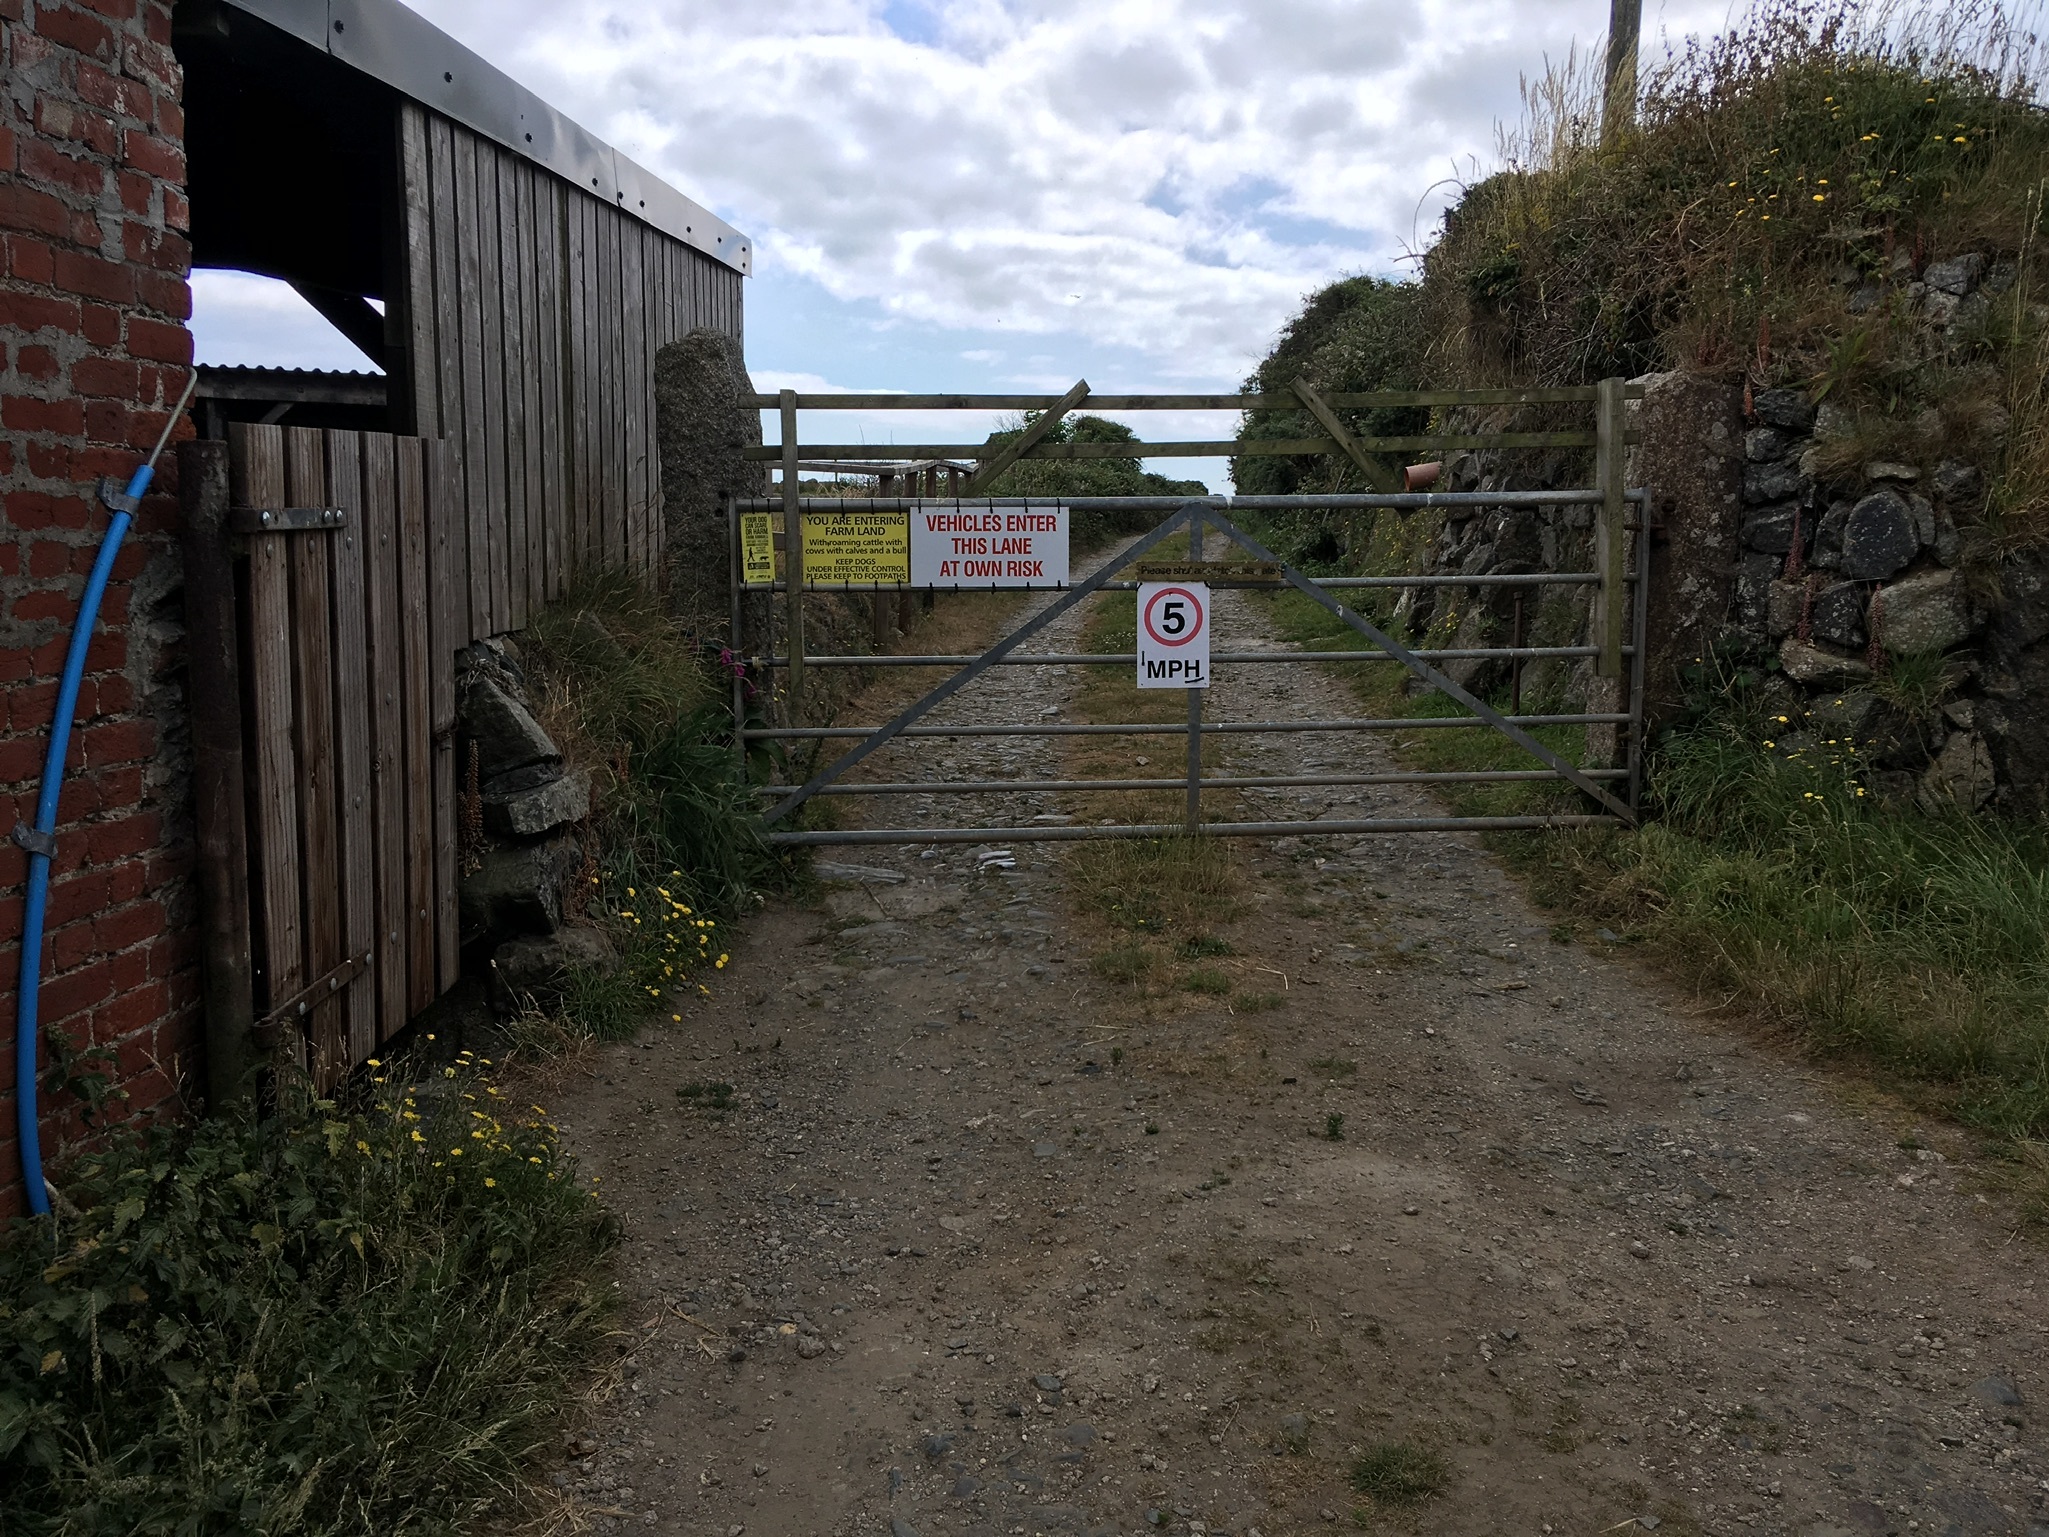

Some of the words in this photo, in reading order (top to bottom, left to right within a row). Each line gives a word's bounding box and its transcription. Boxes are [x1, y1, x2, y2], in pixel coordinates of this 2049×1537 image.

[806, 516, 828, 525] YOU
[832, 516, 852, 525] ARE
[854, 516, 905, 525] ENTERING
[926, 514, 1002, 532] VEHICLES
[1006, 514, 1057, 532] ENTER
[825, 527, 854, 536] FARM
[858, 527, 886, 536] LAND
[829, 539, 860, 547] roaming
[951, 538, 987, 554] THIS
[992, 538, 1032, 554] LANE
[940, 560, 960, 577] AT
[964, 560, 1002, 577] OWN
[1007, 560, 1044, 577] RISK
[1162, 602, 1186, 634] 5
[1147, 660, 1200, 678] MPH
